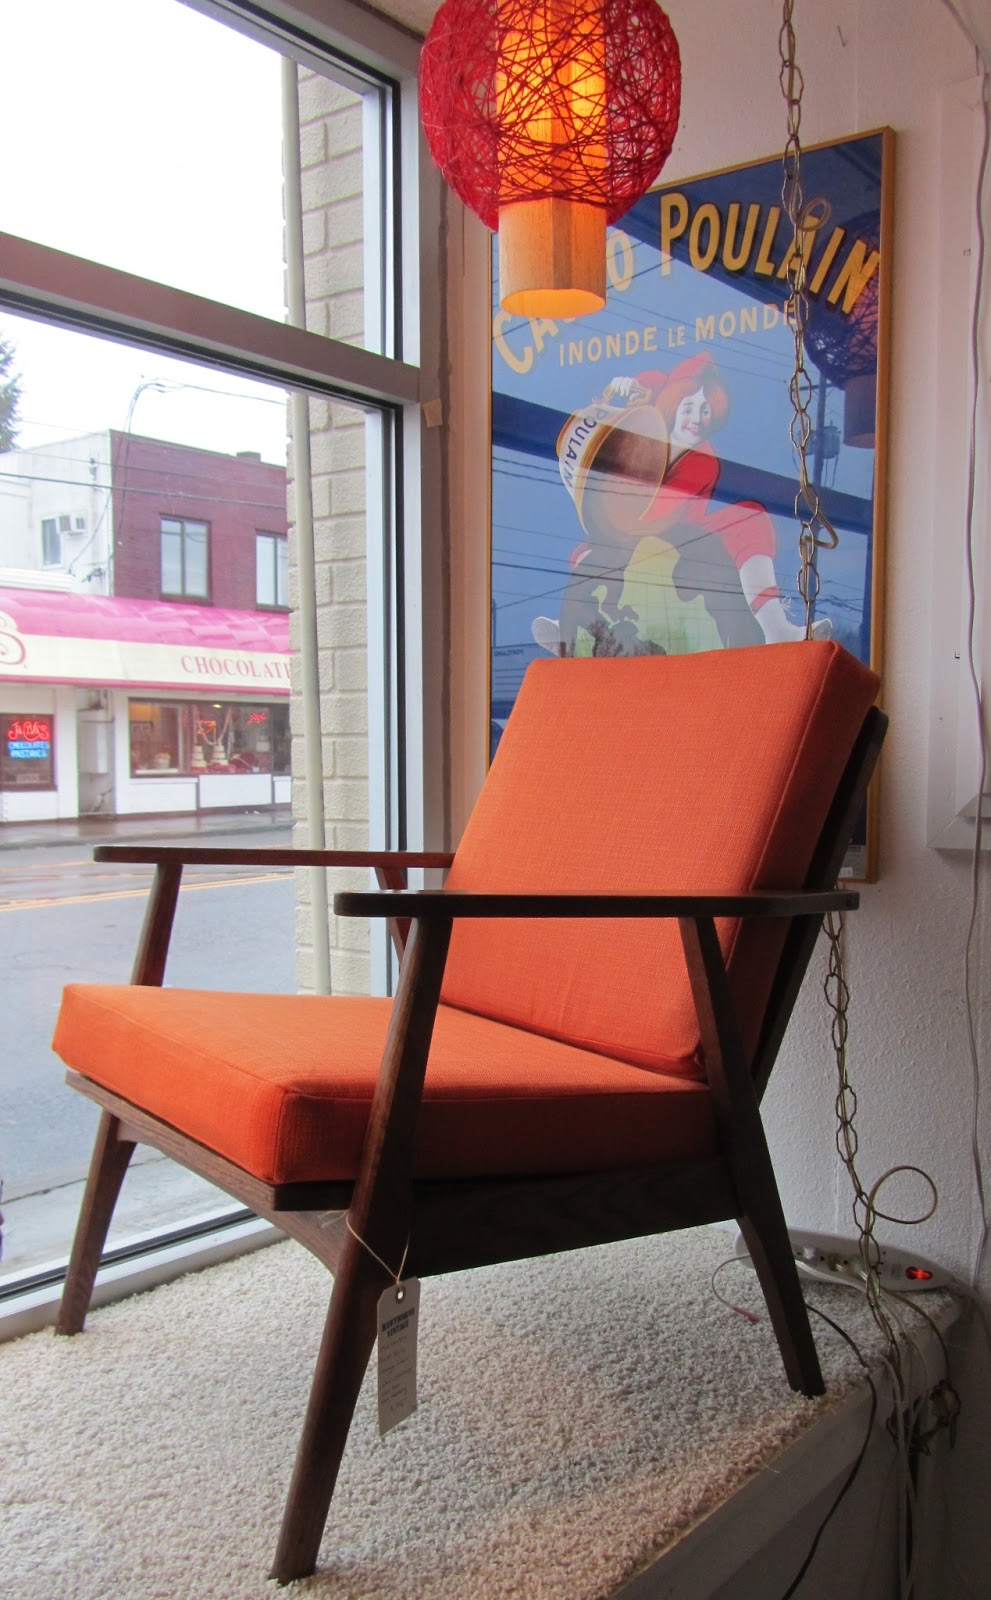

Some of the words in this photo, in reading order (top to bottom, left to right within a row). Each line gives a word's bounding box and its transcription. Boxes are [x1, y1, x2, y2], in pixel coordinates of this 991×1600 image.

[660, 192, 880, 315] POULAIN
[559, 326, 658, 367] INONDE
[668, 326, 685, 347] LE
[695, 300, 797, 342] MONDE
